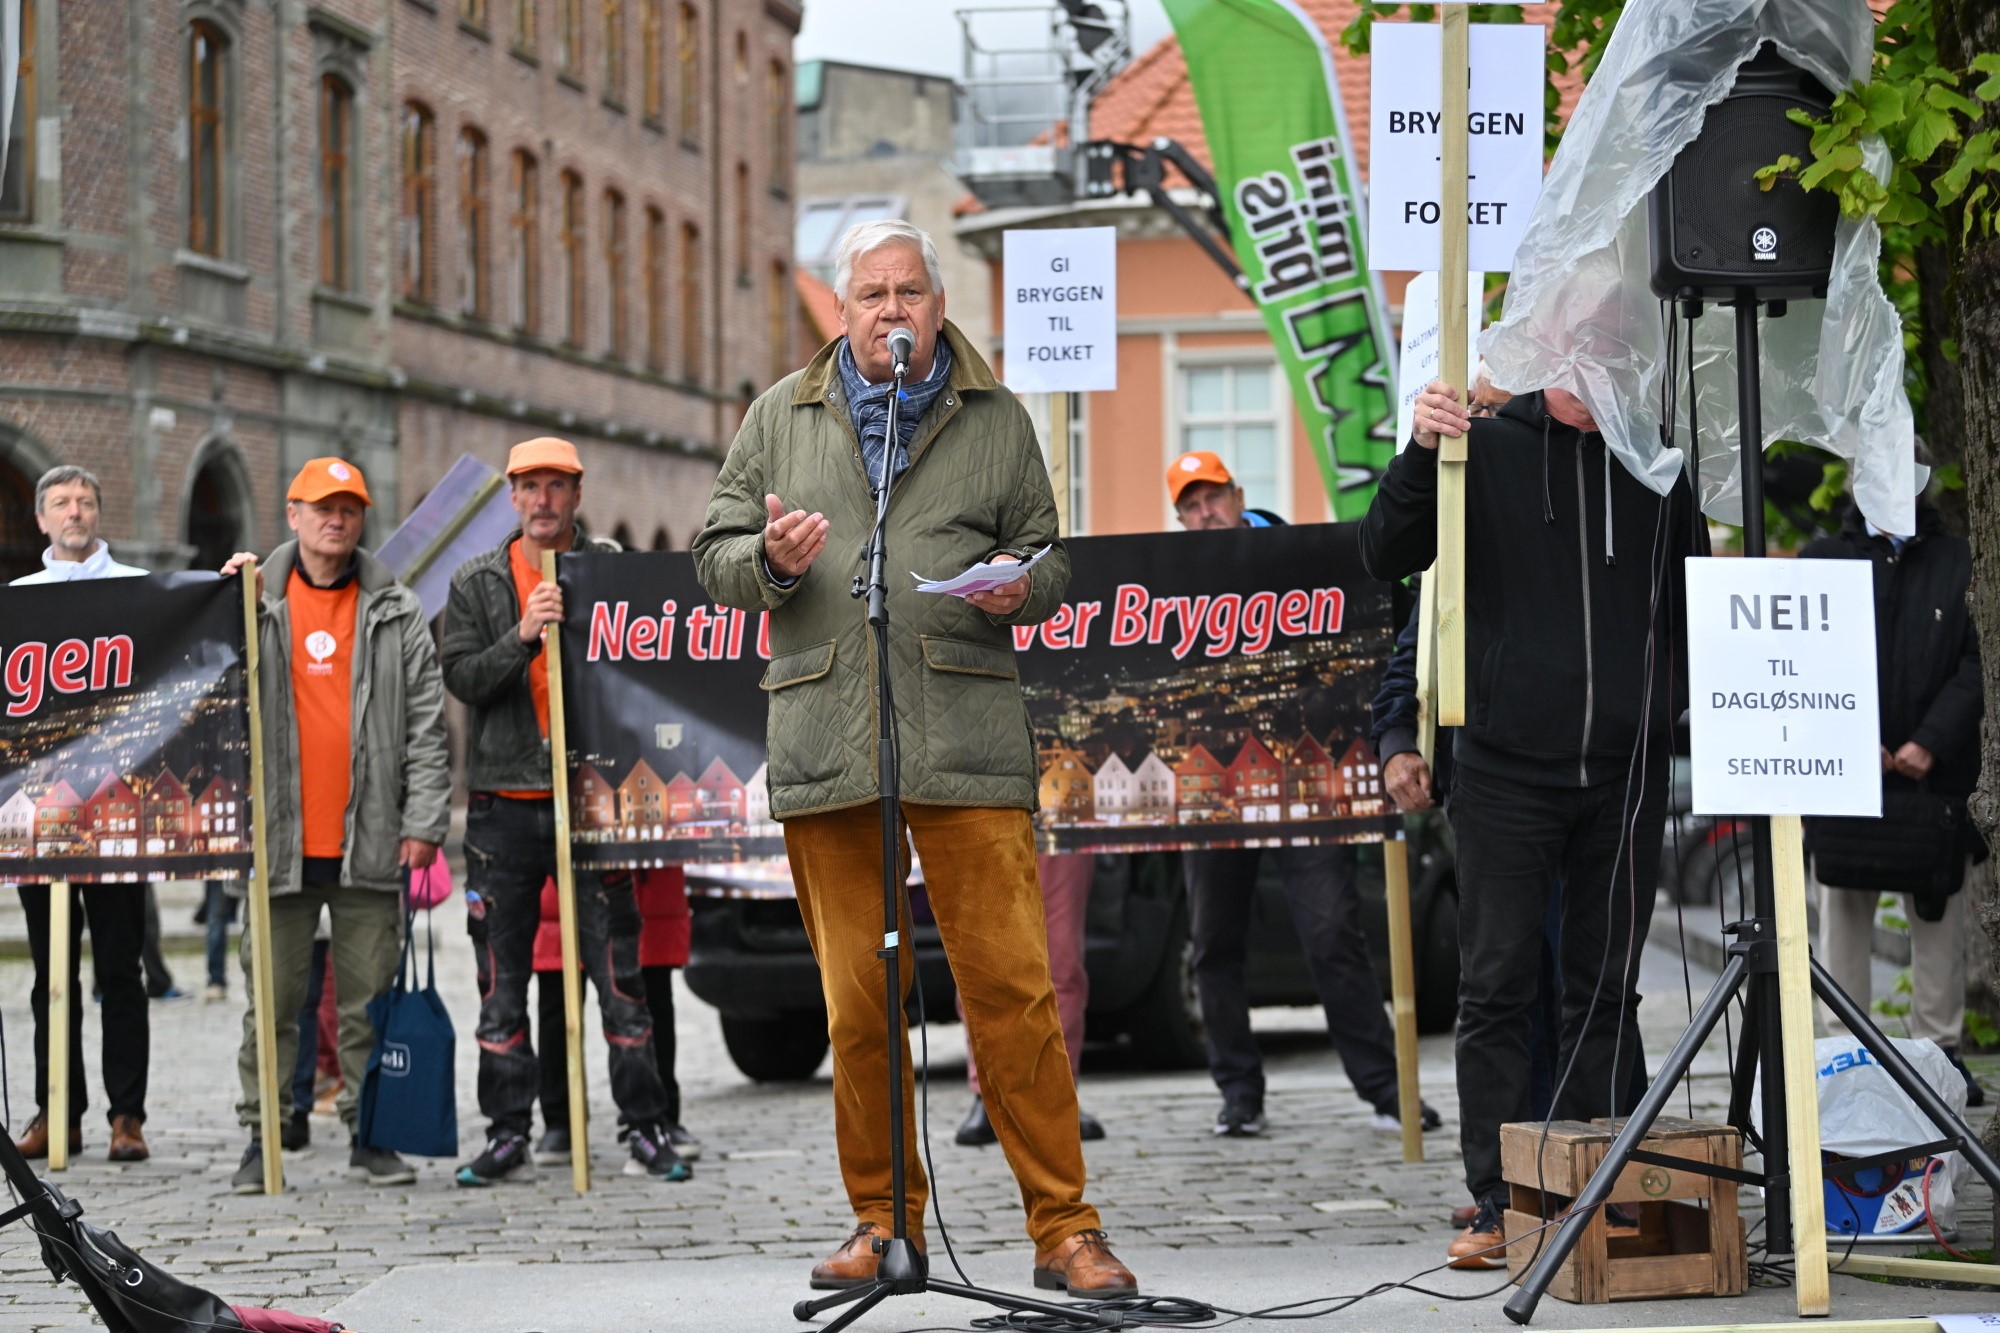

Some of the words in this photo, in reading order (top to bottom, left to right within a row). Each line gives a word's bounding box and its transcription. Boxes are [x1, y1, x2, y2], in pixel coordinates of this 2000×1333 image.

[1389, 111, 1524, 135] BRYGEN
[1754, 252, 1777, 260] YAMAHA
[1050, 257, 1070, 273] GI
[1016, 286, 1104, 303] BRYGGEN
[1048, 316, 1073, 331] TIL
[1027, 345, 1094, 361] FOLKET
[1730, 593, 1830, 632] NEI!
[1012, 600, 1101, 651] ver
[1110, 583, 1345, 660] Bryggen
[587, 599, 677, 662] Nei
[686, 603, 746, 661] til
[4, 634, 134, 717] gen
[1767, 659, 1799, 676] TIL
[1711, 690, 1856, 711] DAGLØSNING
[1782, 725, 1787, 742] I
[1727, 758, 1843, 776] SENTRUM!
